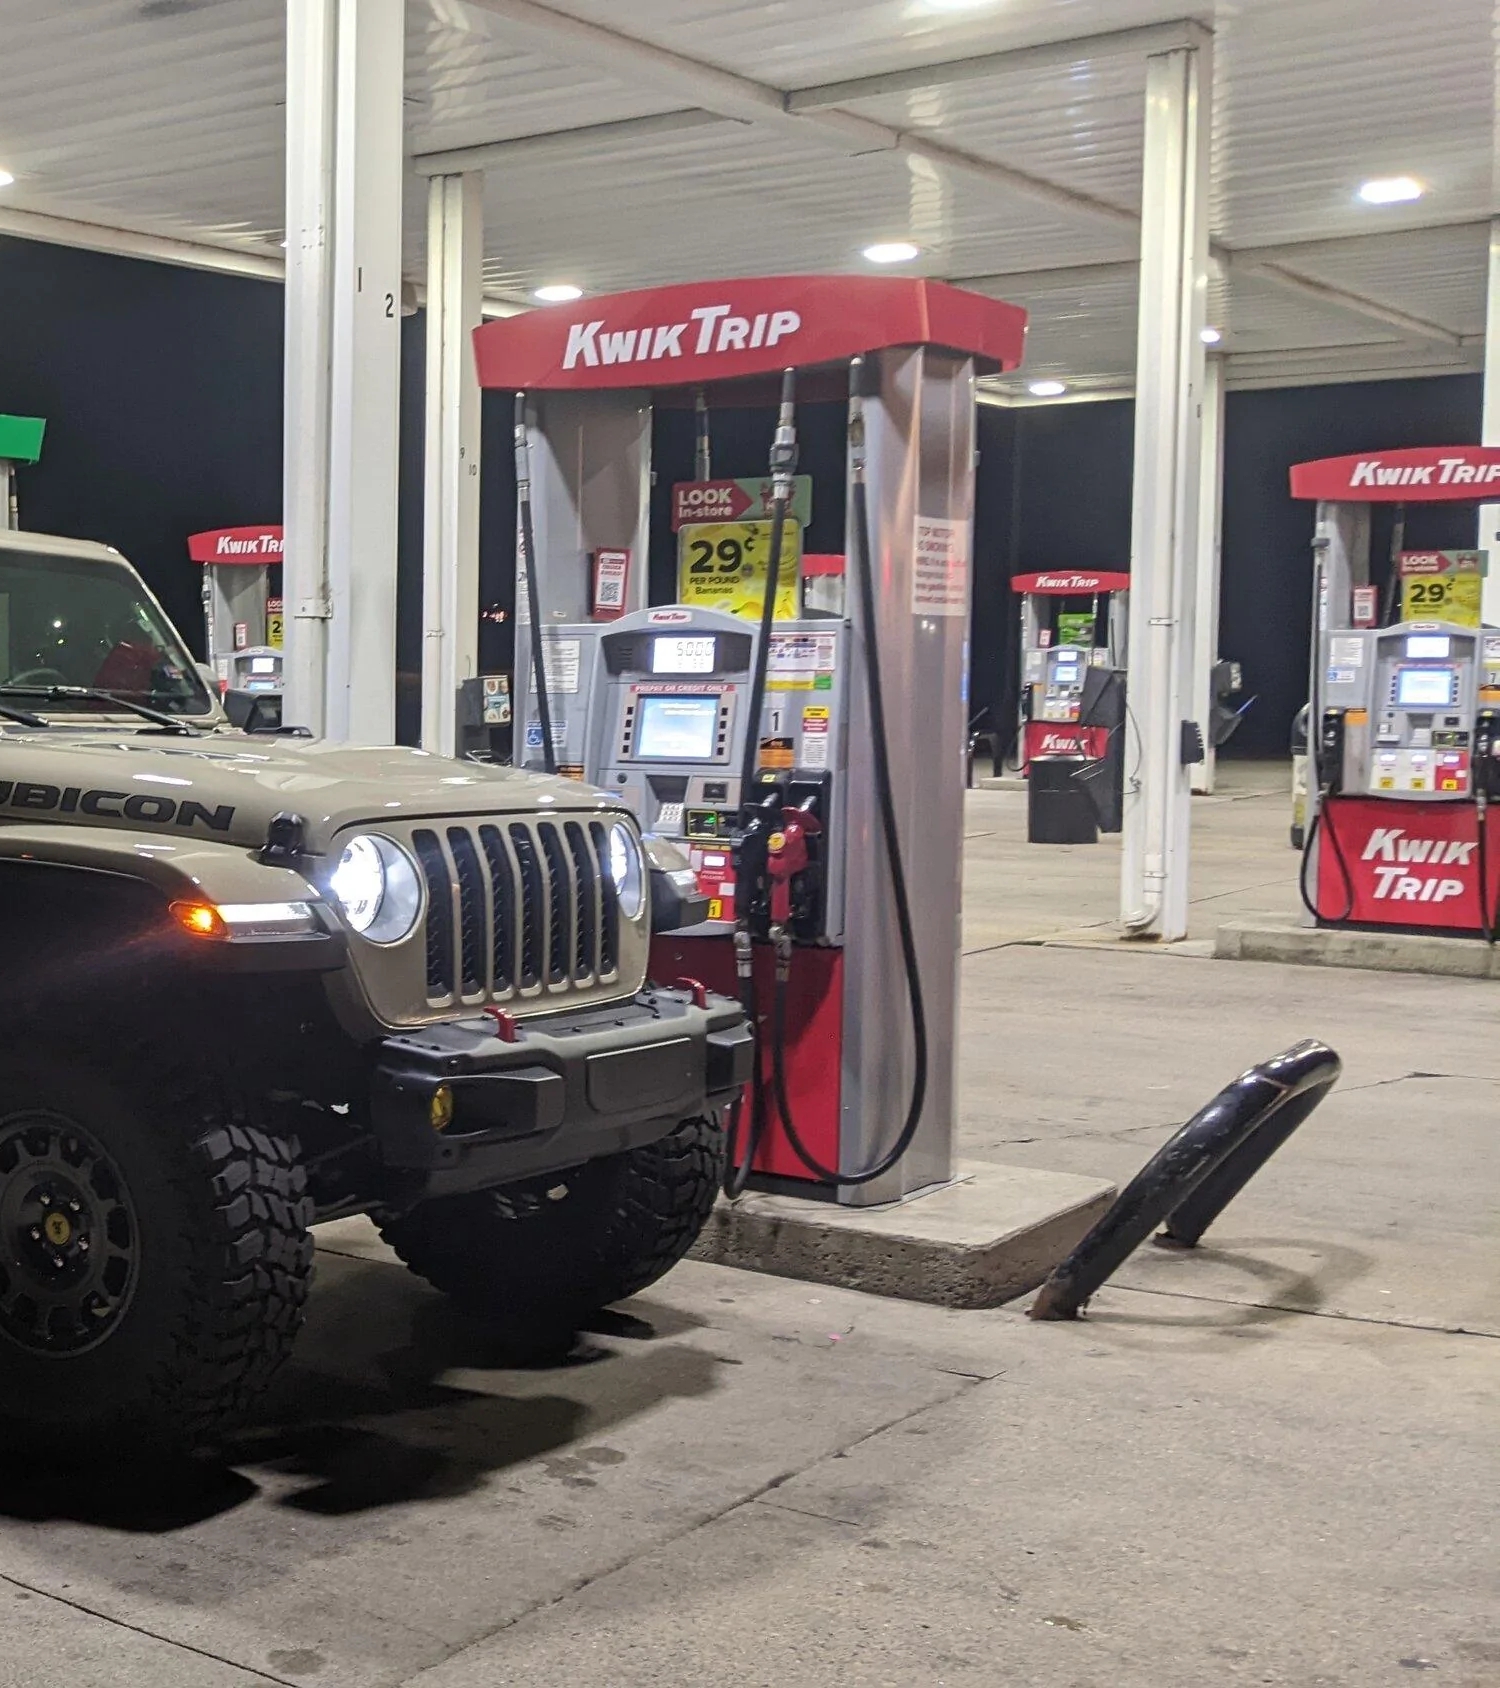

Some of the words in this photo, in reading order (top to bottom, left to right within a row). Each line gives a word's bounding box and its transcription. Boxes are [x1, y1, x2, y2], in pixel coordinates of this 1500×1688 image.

[385, 292, 395, 318] 2
[678, 487, 733, 506] LOOK
[258, 535, 283, 553] TRI
[689, 576, 706, 585] PER
[707, 575, 740, 585] POUND
[771, 711, 780, 732] 1
